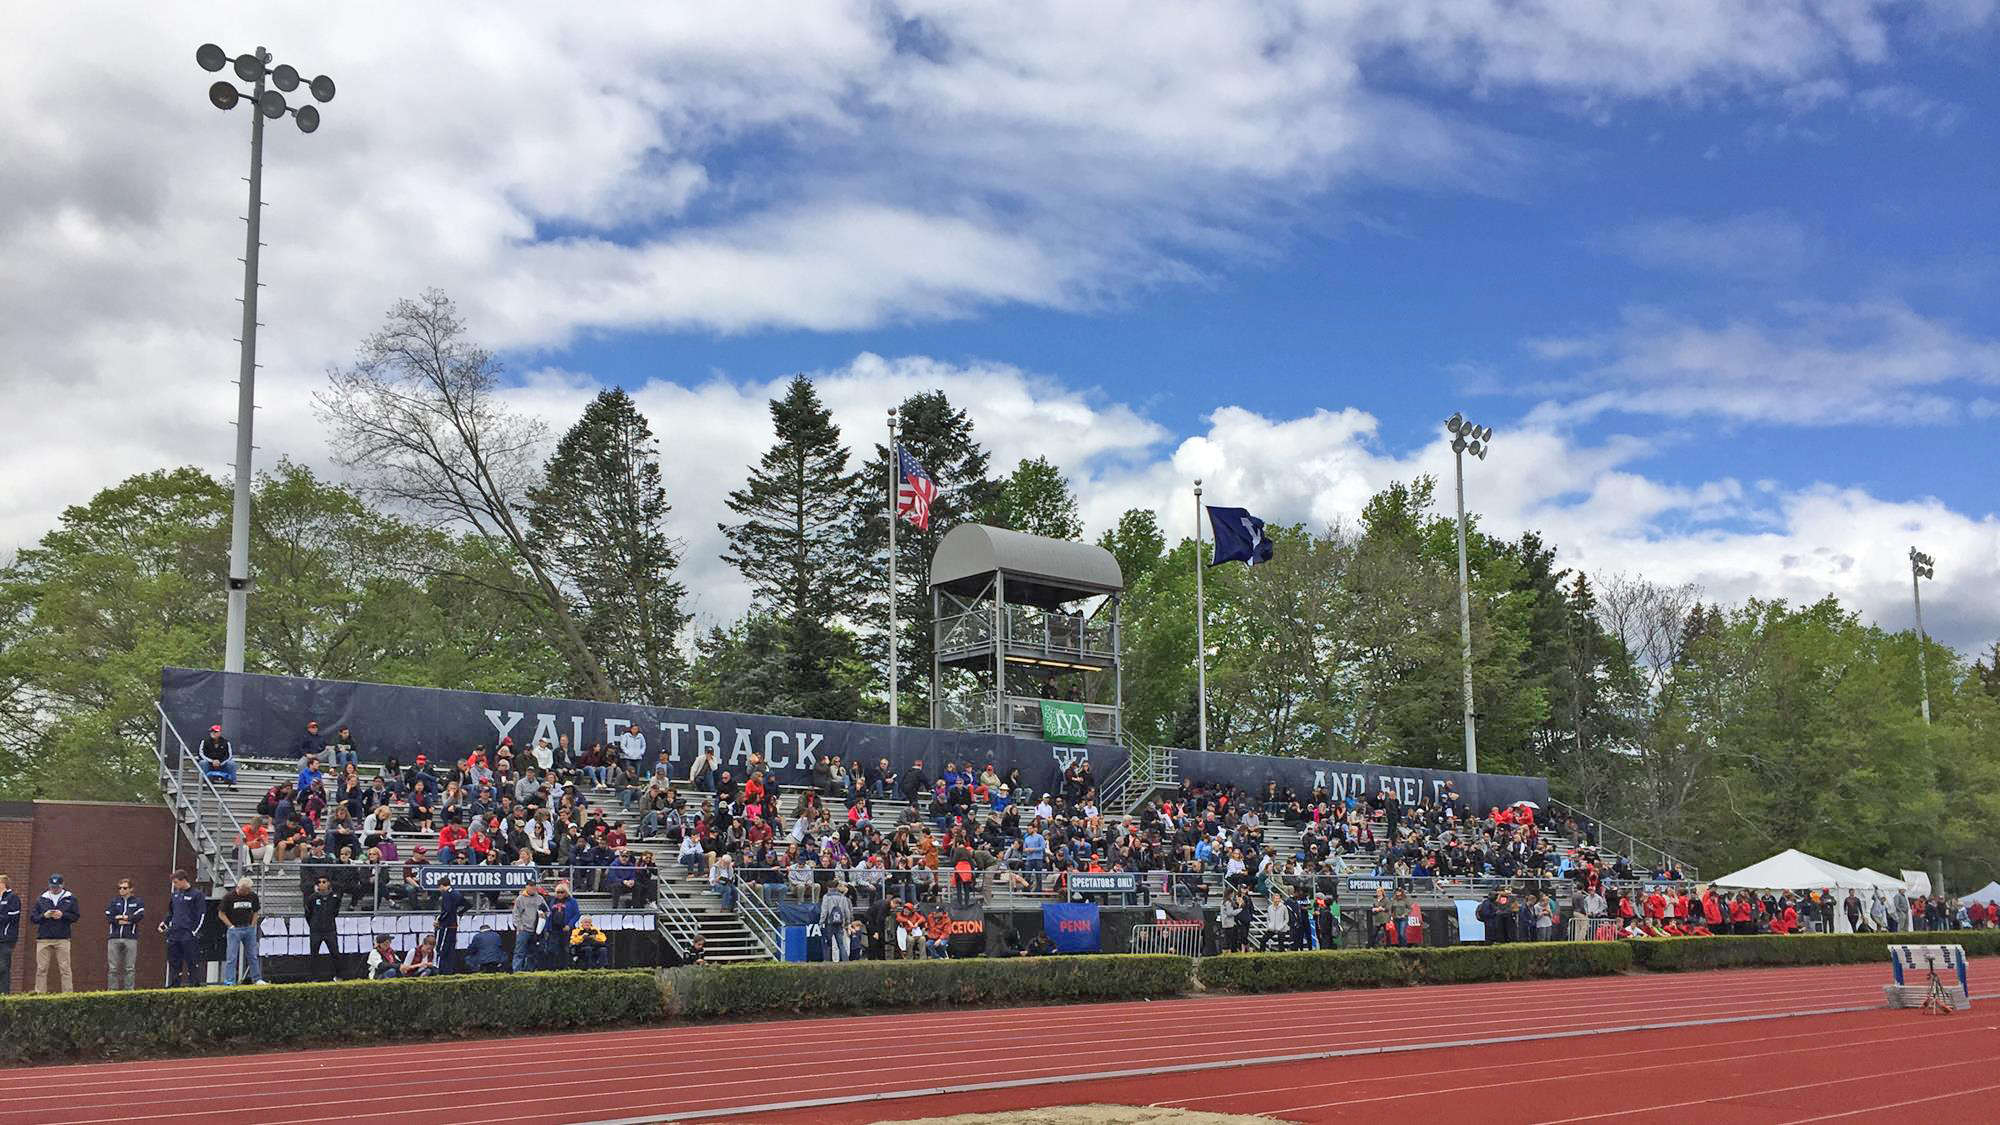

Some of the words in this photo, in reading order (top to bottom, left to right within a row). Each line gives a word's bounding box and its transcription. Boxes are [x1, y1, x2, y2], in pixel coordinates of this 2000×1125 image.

[1056, 713, 1085, 731] IVY
[1057, 727, 1088, 738] LEAGUE
[660, 722, 824, 770] TRACK
[1313, 770, 1366, 801] AND
[505, 872, 533, 886] ONLY
[1072, 877, 1115, 888] SPECTATORS
[1117, 877, 1133, 888] ONLY
[1349, 880, 1380, 890] SPECTATORS
[950, 920, 984, 934] CETON
[1059, 919, 1092, 933] PENN
